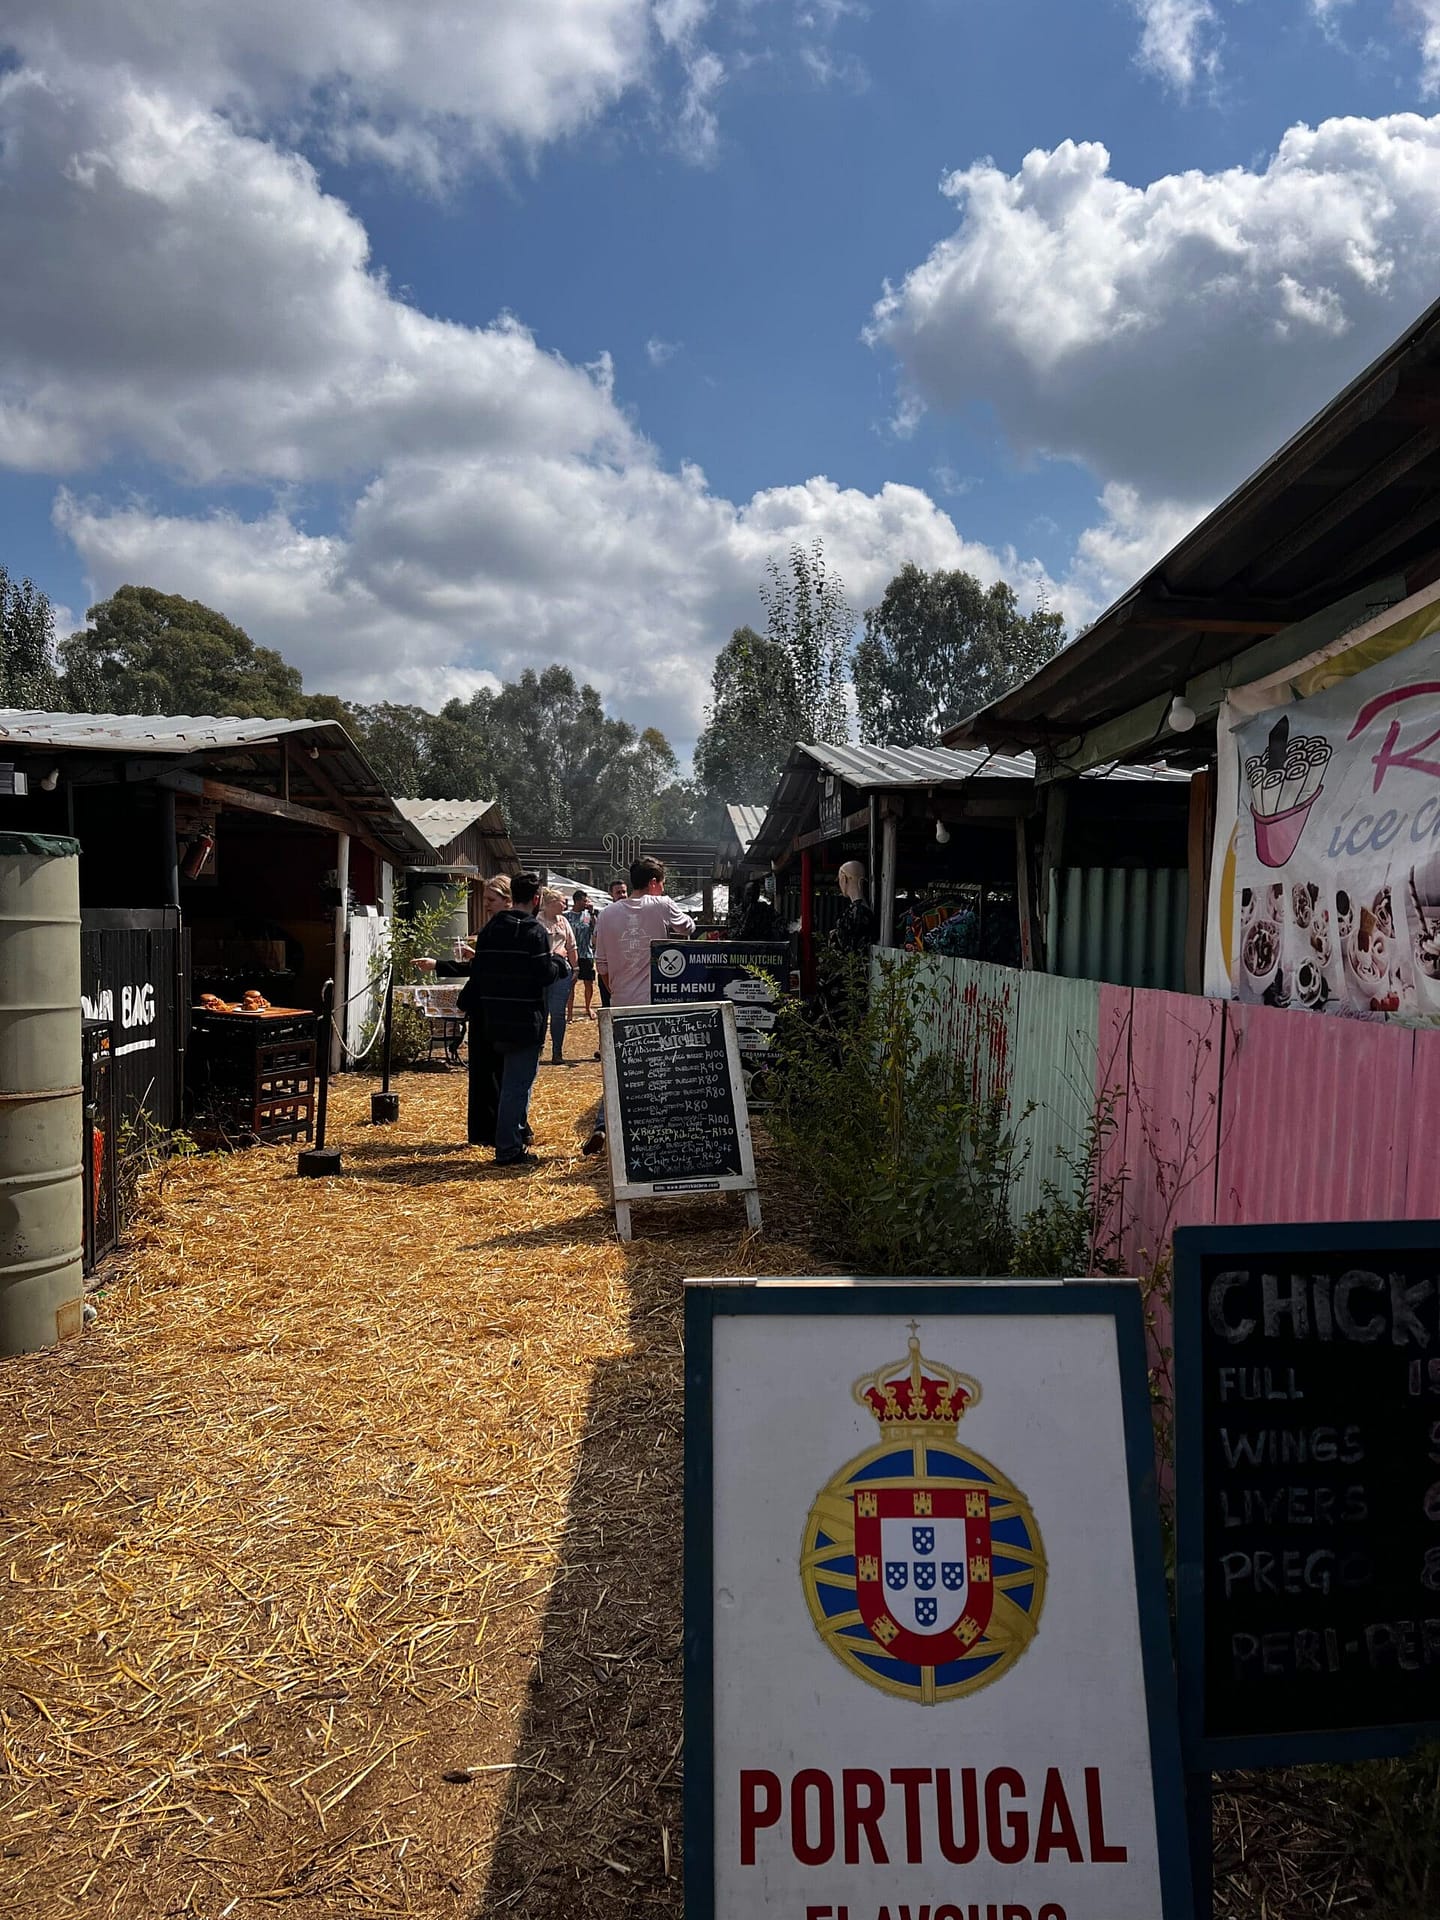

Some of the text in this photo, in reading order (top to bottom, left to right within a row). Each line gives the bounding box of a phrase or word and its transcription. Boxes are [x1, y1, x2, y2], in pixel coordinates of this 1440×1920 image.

[1328, 806, 1408, 858] ice
[730, 953, 747, 965] MINI
[750, 954, 783, 966] KITCHEN
[653, 983, 716, 993] THE MENU
[121, 983, 156, 1029] BAG
[624, 1021, 662, 1038] PATTY
[660, 1032, 711, 1047] KITCHEN
[685, 1100, 708, 1112] R80
[708, 1114, 729, 1125] R100
[712, 1127, 734, 1138] R130
[1208, 1268, 1440, 1348] CHICK
[1218, 1366, 1304, 1402] FULL
[1219, 1424, 1367, 1468] WINGS
[1218, 1483, 1370, 1527] LIVERS
[739, 1766, 1128, 1867] PORTUGAL
